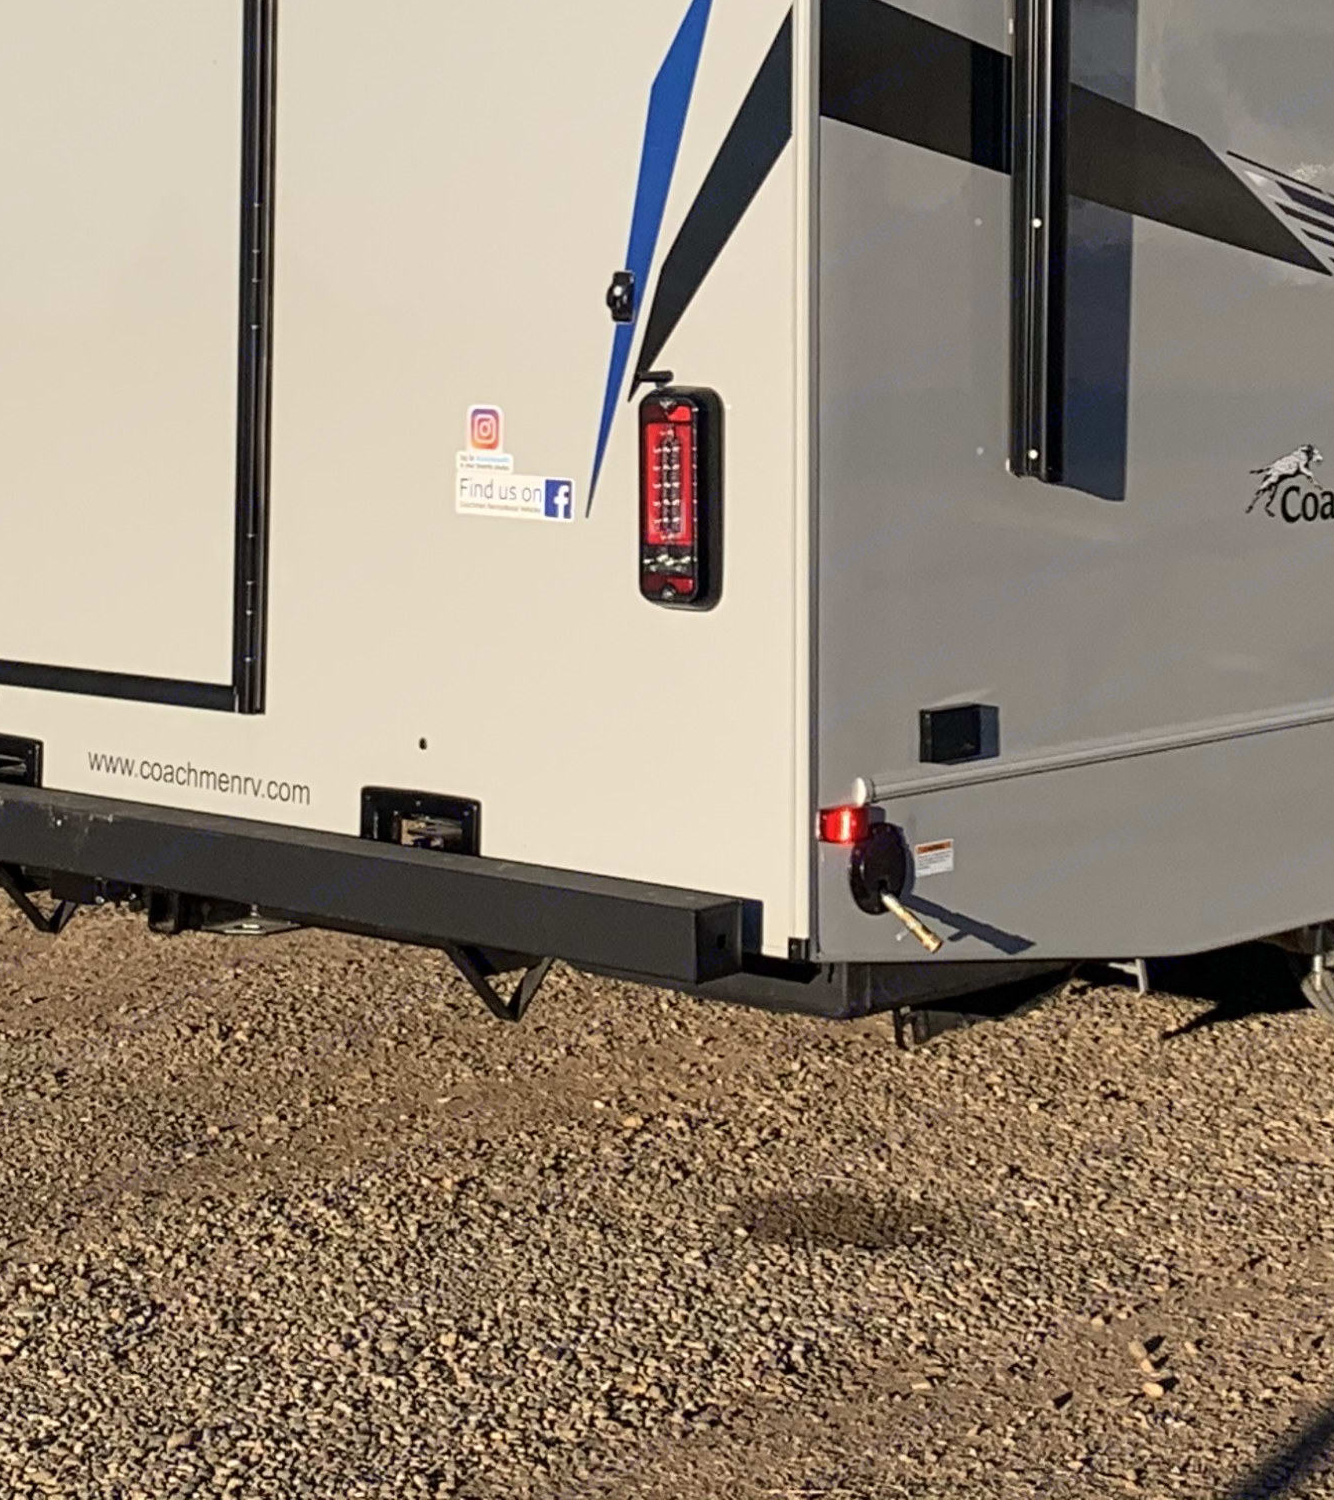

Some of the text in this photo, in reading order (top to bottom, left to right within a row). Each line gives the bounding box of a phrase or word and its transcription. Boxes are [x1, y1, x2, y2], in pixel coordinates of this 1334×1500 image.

[459, 477, 495, 500] Find
[498, 484, 517, 501] us
[521, 486, 543, 503] on
[87, 750, 311, 806] www.coachmenrv.com
